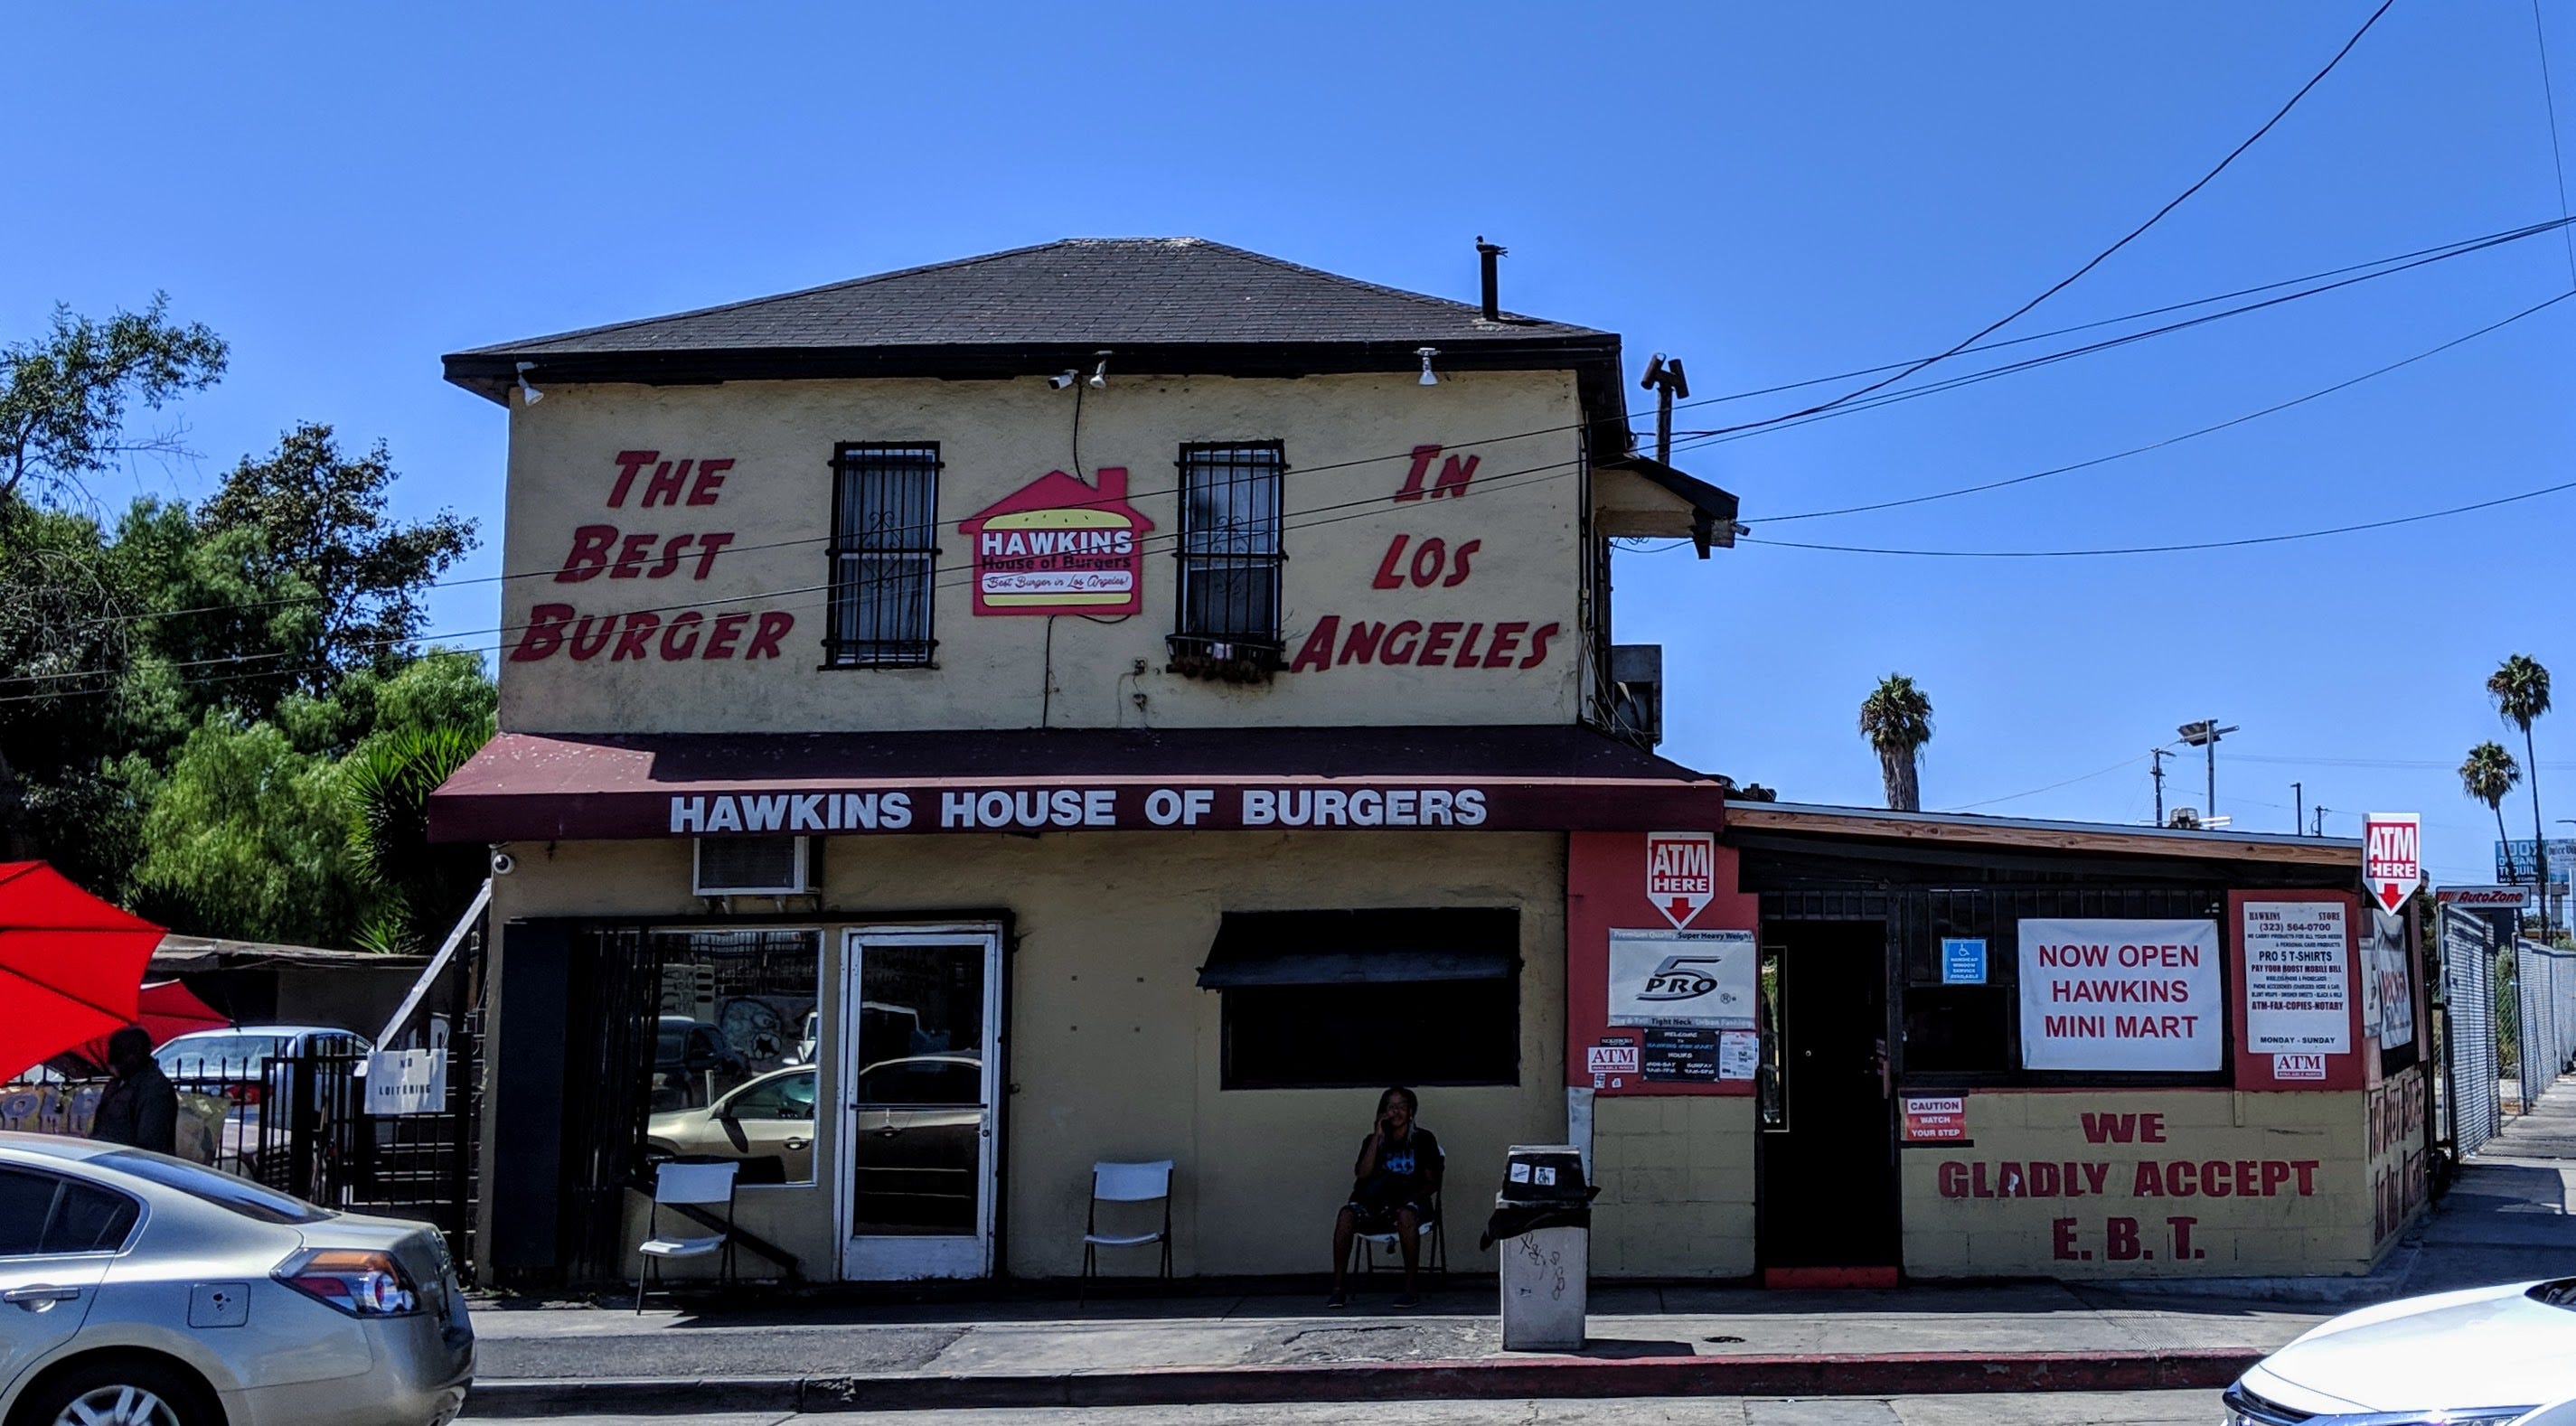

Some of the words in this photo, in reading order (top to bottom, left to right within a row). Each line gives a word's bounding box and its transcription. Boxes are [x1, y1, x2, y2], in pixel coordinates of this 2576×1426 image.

[608, 451, 734, 508] THE
[1394, 444, 1481, 502] IN
[982, 530, 1133, 556] HAWKINS
[555, 527, 733, 583] BEST
[982, 556, 1037, 571] House
[1041, 556, 1057, 569] of
[1063, 555, 1130, 572] Burgers
[1372, 534, 1481, 590] LOS
[987, 577, 1012, 589] Best
[1015, 577, 1052, 589] Burger
[1054, 577, 1064, 586] in
[1067, 574, 1084, 590] Los
[1087, 575, 1129, 589] Angeles!
[511, 605, 794, 662] BURGER
[1290, 614, 1560, 673] ANGELES
[670, 792, 912, 833] HAWKINS
[941, 789, 1117, 829] HOUSE
[1144, 788, 1215, 827] OF
[1242, 788, 1488, 827] BURGERS
[2368, 826, 2416, 862] ATM
[1651, 843, 1708, 877] ATM
[2369, 863, 2416, 879] HERE
[1653, 878, 1708, 893] HERE
[2458, 891, 2524, 903] AutoZone
[2249, 912, 2280, 920] HAWKINS
[2318, 912, 2340, 920] STORE
[1678, 932, 1699, 940] Super
[1701, 933, 1724, 941] Heavy
[1725, 933, 1752, 941] Weight
[2259, 923, 2284, 933] (323)
[2287, 923, 2331, 931] 564-0700
[2038, 945, 2112, 967] NOW
[2118, 945, 2200, 968] OPEN
[2259, 951, 2278, 961] PRO
[2281, 951, 2286, 961] 5
[2289, 951, 2332, 961] T-SHIRTS
[1645, 978, 1718, 994] PRO
[2052, 980, 2189, 1003] HAWKINS
[2252, 1001, 2343, 1010] ATM-FAX-COPIES-NOTARY
[1651, 1018, 1672, 1026] Tight
[2045, 1016, 2105, 1038] MINI
[2115, 1015, 2198, 1038] MART
[400, 1058, 412, 1068] NO
[1592, 1049, 1635, 1063] ATM
[2278, 1055, 2321, 1070] ATM
[2081, 1112, 2167, 1144] WE
[1938, 1161, 2111, 1198] GLADLY
[2134, 1160, 2319, 1197] ACCEPT
[2053, 1218, 2092, 1261] E.
[2106, 1218, 2153, 1260] B.
[2166, 1217, 2205, 1260] T.
